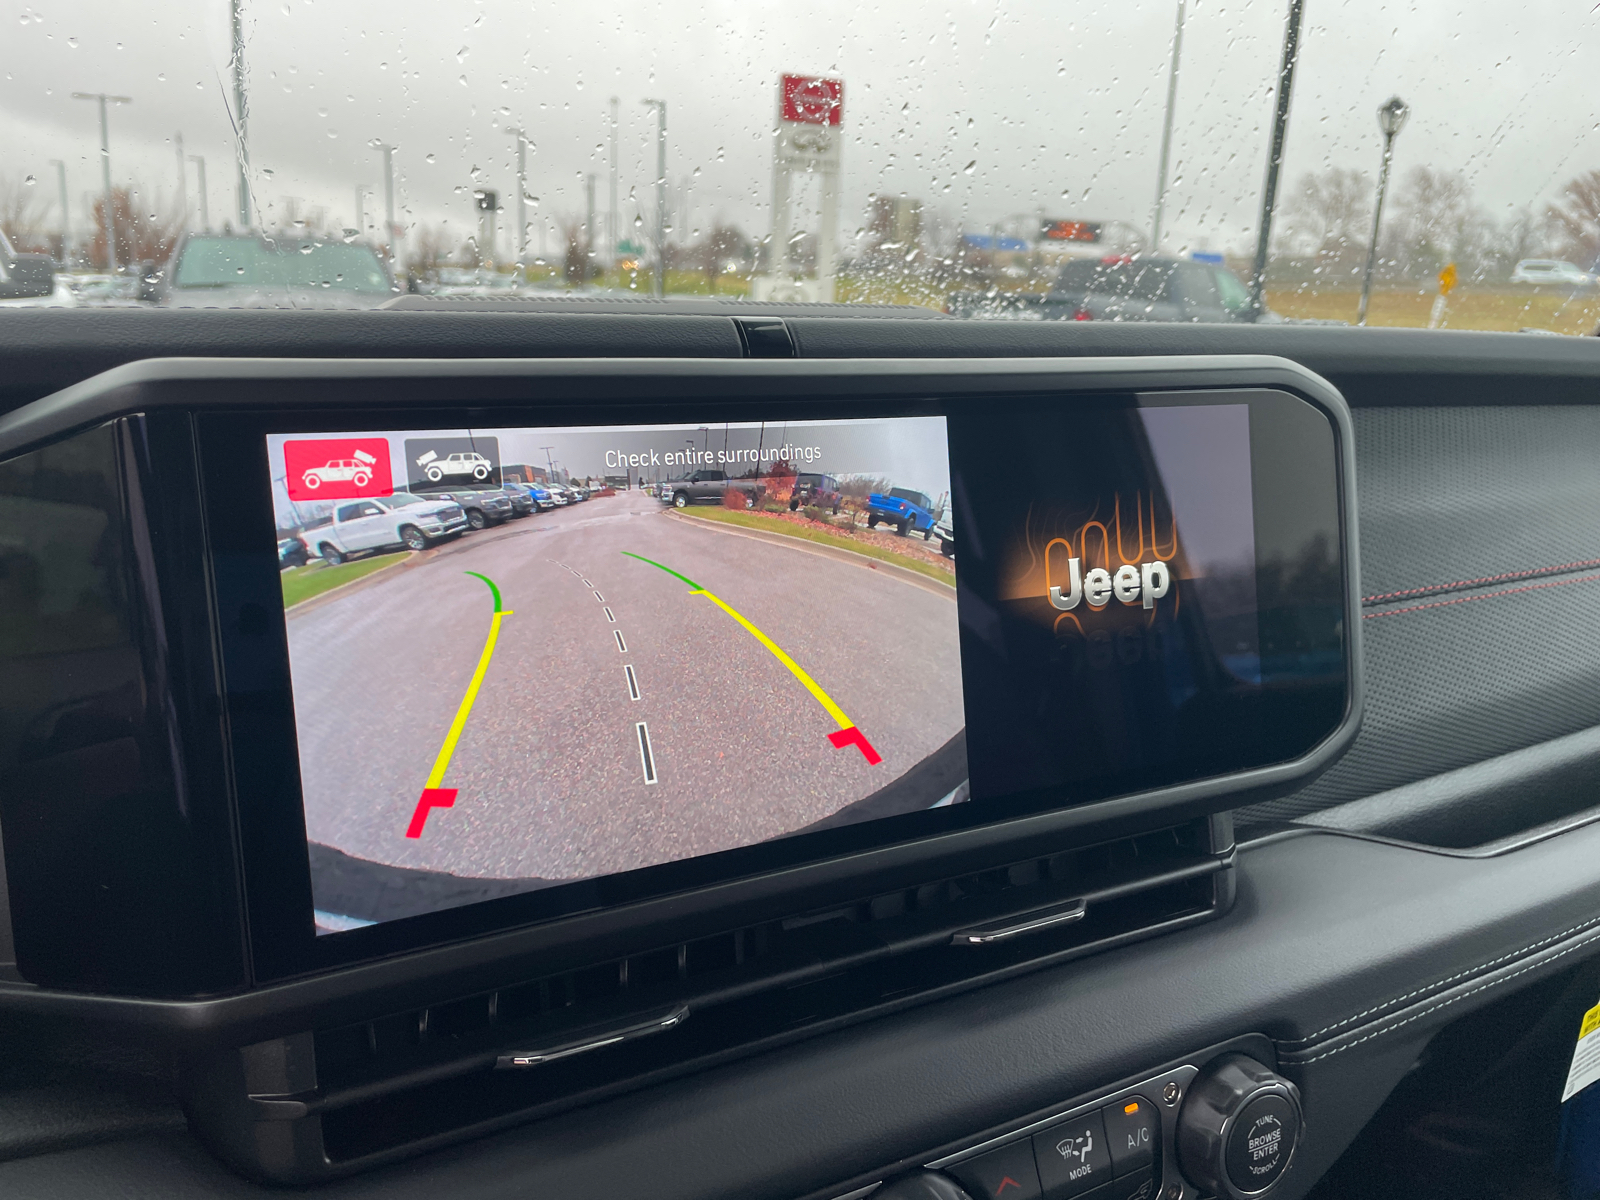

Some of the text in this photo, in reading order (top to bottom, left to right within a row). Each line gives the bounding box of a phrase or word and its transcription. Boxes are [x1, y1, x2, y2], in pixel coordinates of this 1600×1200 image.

[605, 443, 822, 468] Check entire surroundings
[1049, 556, 1170, 610] Jeep
[1255, 1114, 1274, 1127] TUNE
[1127, 1127, 1149, 1149] A/C
[1248, 1128, 1281, 1150] BROWSE
[1253, 1142, 1278, 1161] ENTER
[1069, 1163, 1092, 1181] MODE
[1252, 1159, 1278, 1175] SCROLL
